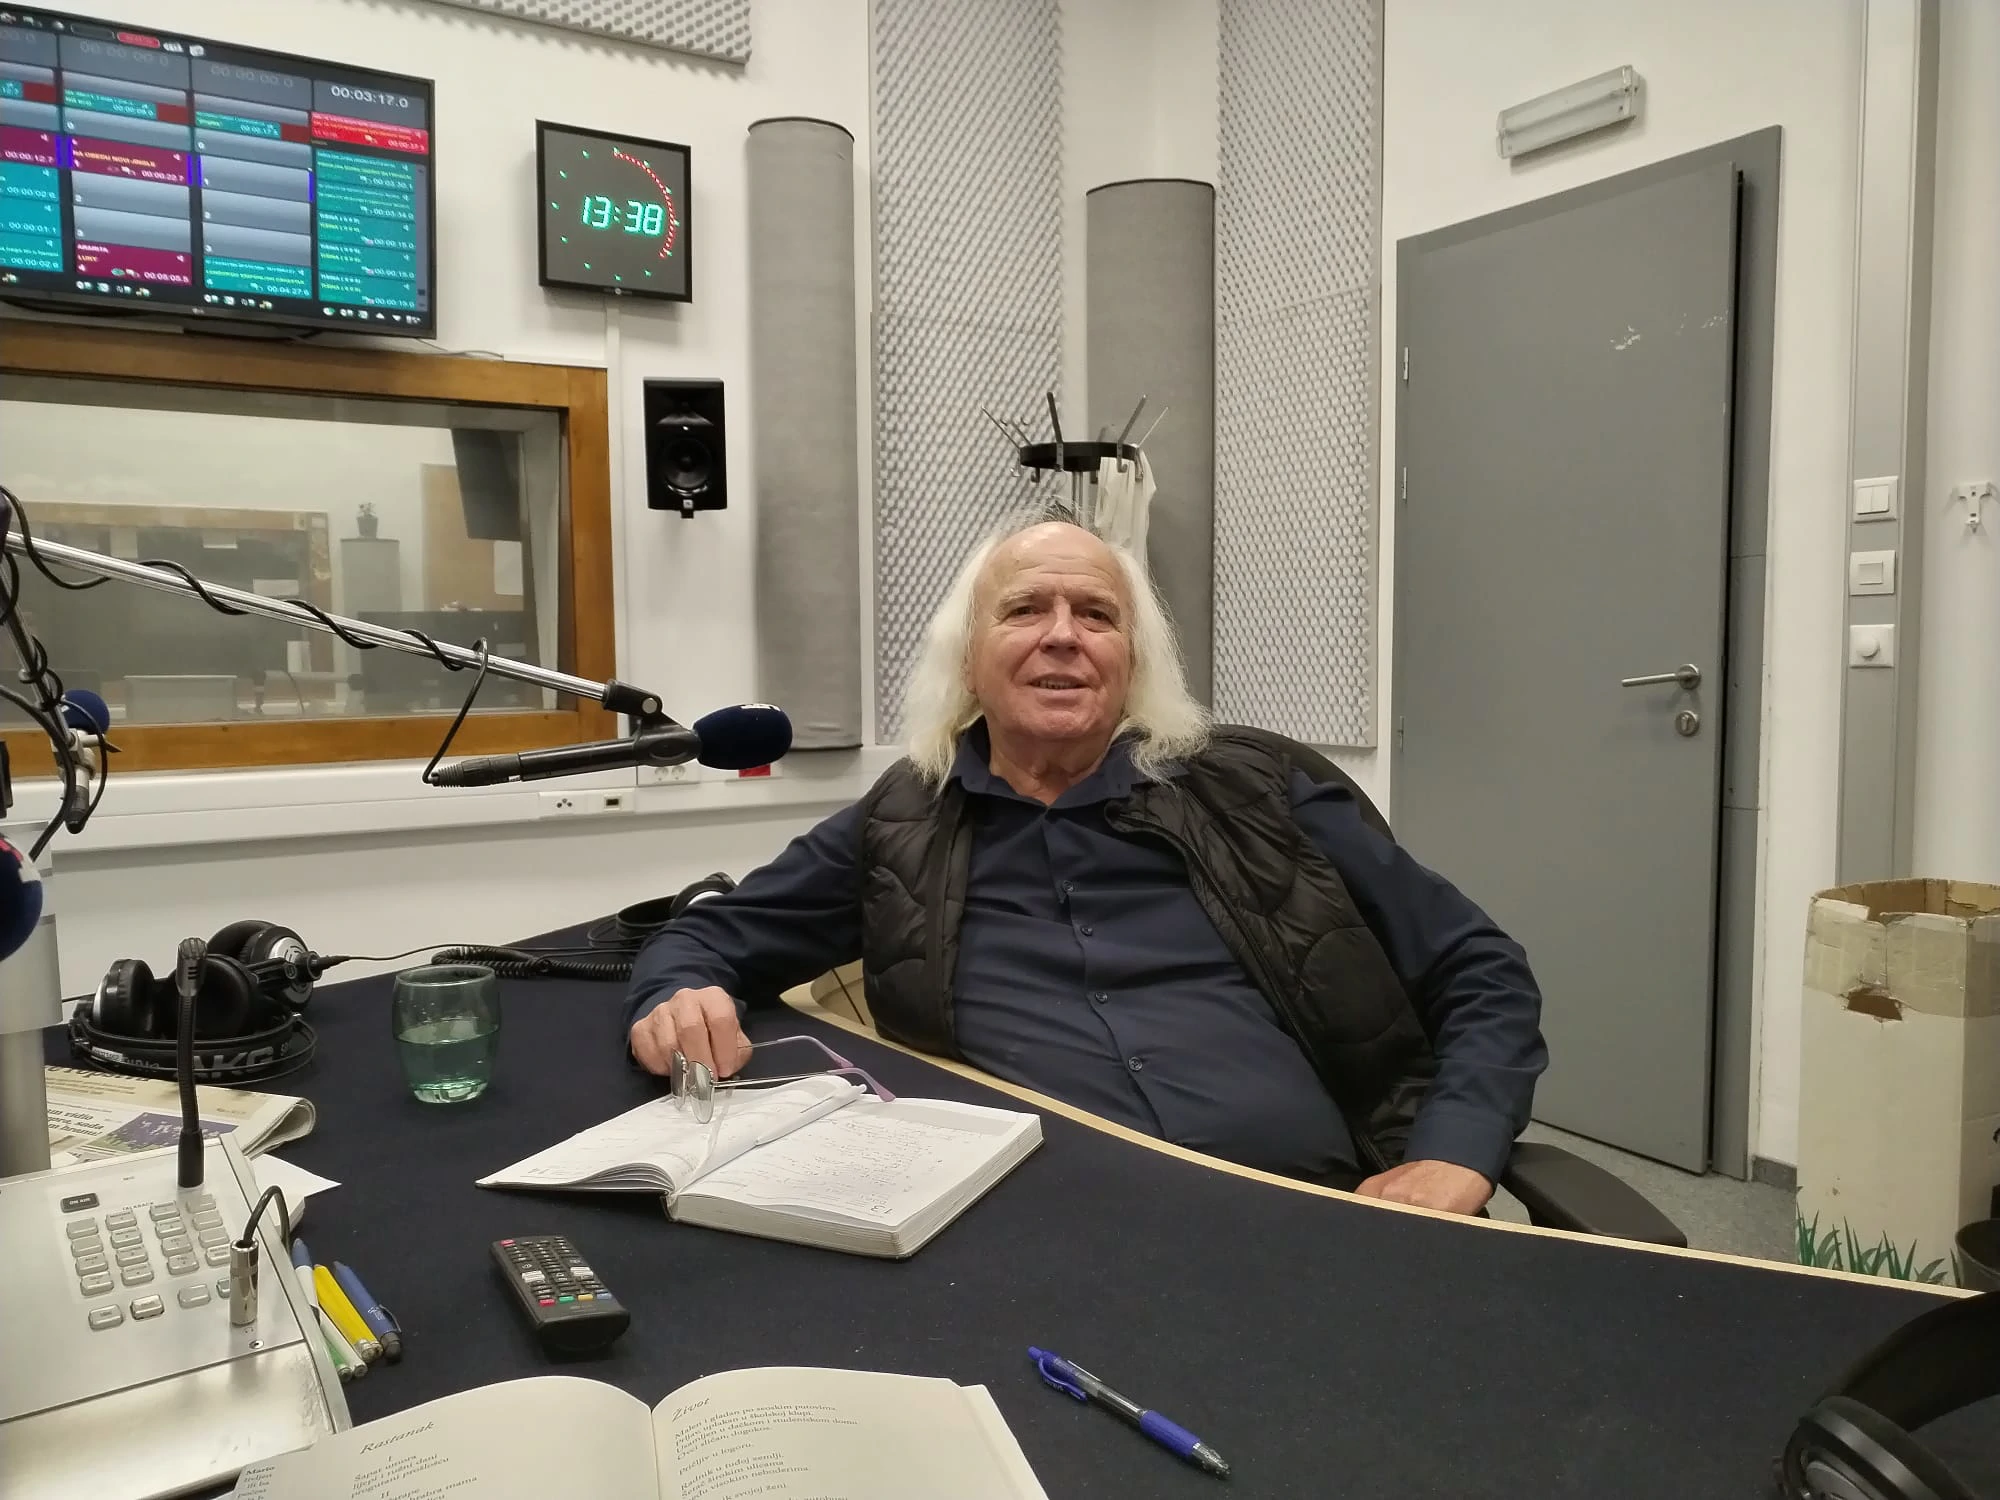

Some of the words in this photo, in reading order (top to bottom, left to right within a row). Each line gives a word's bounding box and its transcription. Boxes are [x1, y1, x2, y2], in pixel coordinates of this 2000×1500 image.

[582, 195, 663, 236] 13:38
[710, 1411, 740, 1423] gladan
[742, 1407, 754, 1415] po
[360, 1421, 435, 1455] Rastanak
